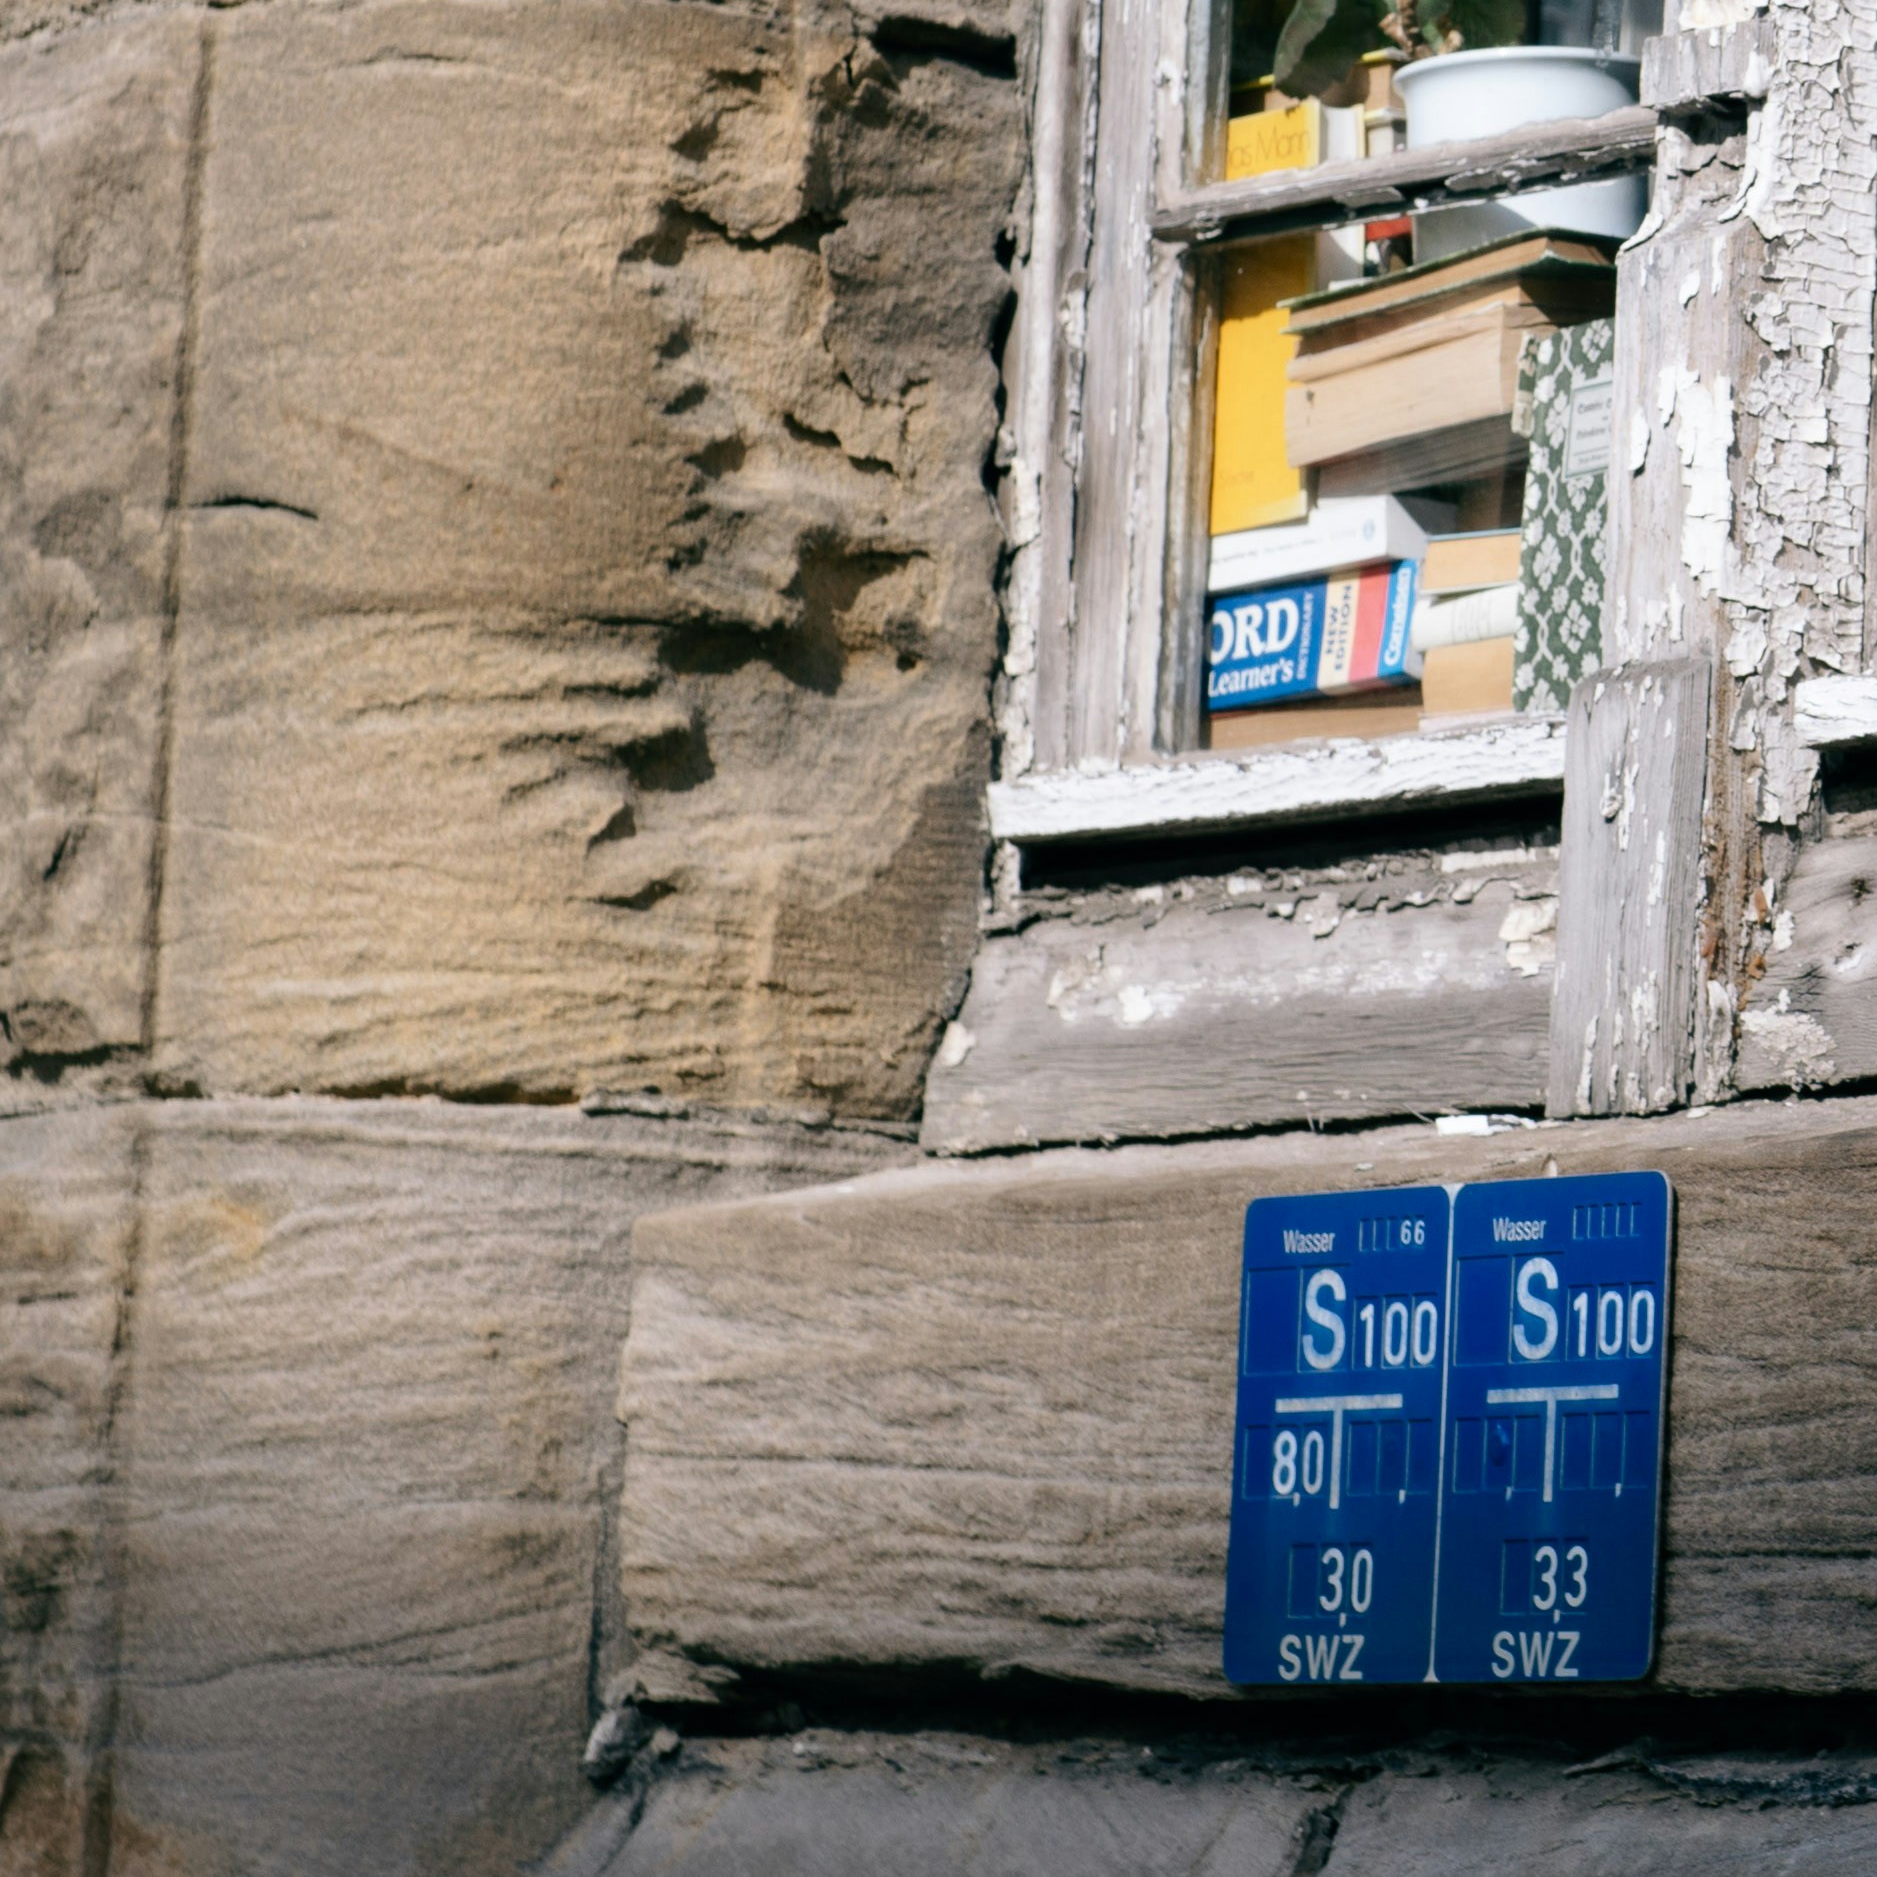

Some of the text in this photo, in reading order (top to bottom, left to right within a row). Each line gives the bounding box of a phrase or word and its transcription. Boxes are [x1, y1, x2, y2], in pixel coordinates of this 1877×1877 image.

[1211, 597, 1300, 666] ORD
[1296, 591, 1315, 680] DICTIONARY
[1326, 607, 1339, 656] NEW
[1334, 586, 1353, 672] EDITION
[1208, 656, 1295, 698] Learner's
[1283, 1219, 1426, 1253] Wasser 66
[1492, 1217, 1547, 1242] Wasser
[1277, 1633, 1366, 1682] SWZ
[1490, 1630, 1582, 1678] SWZ
